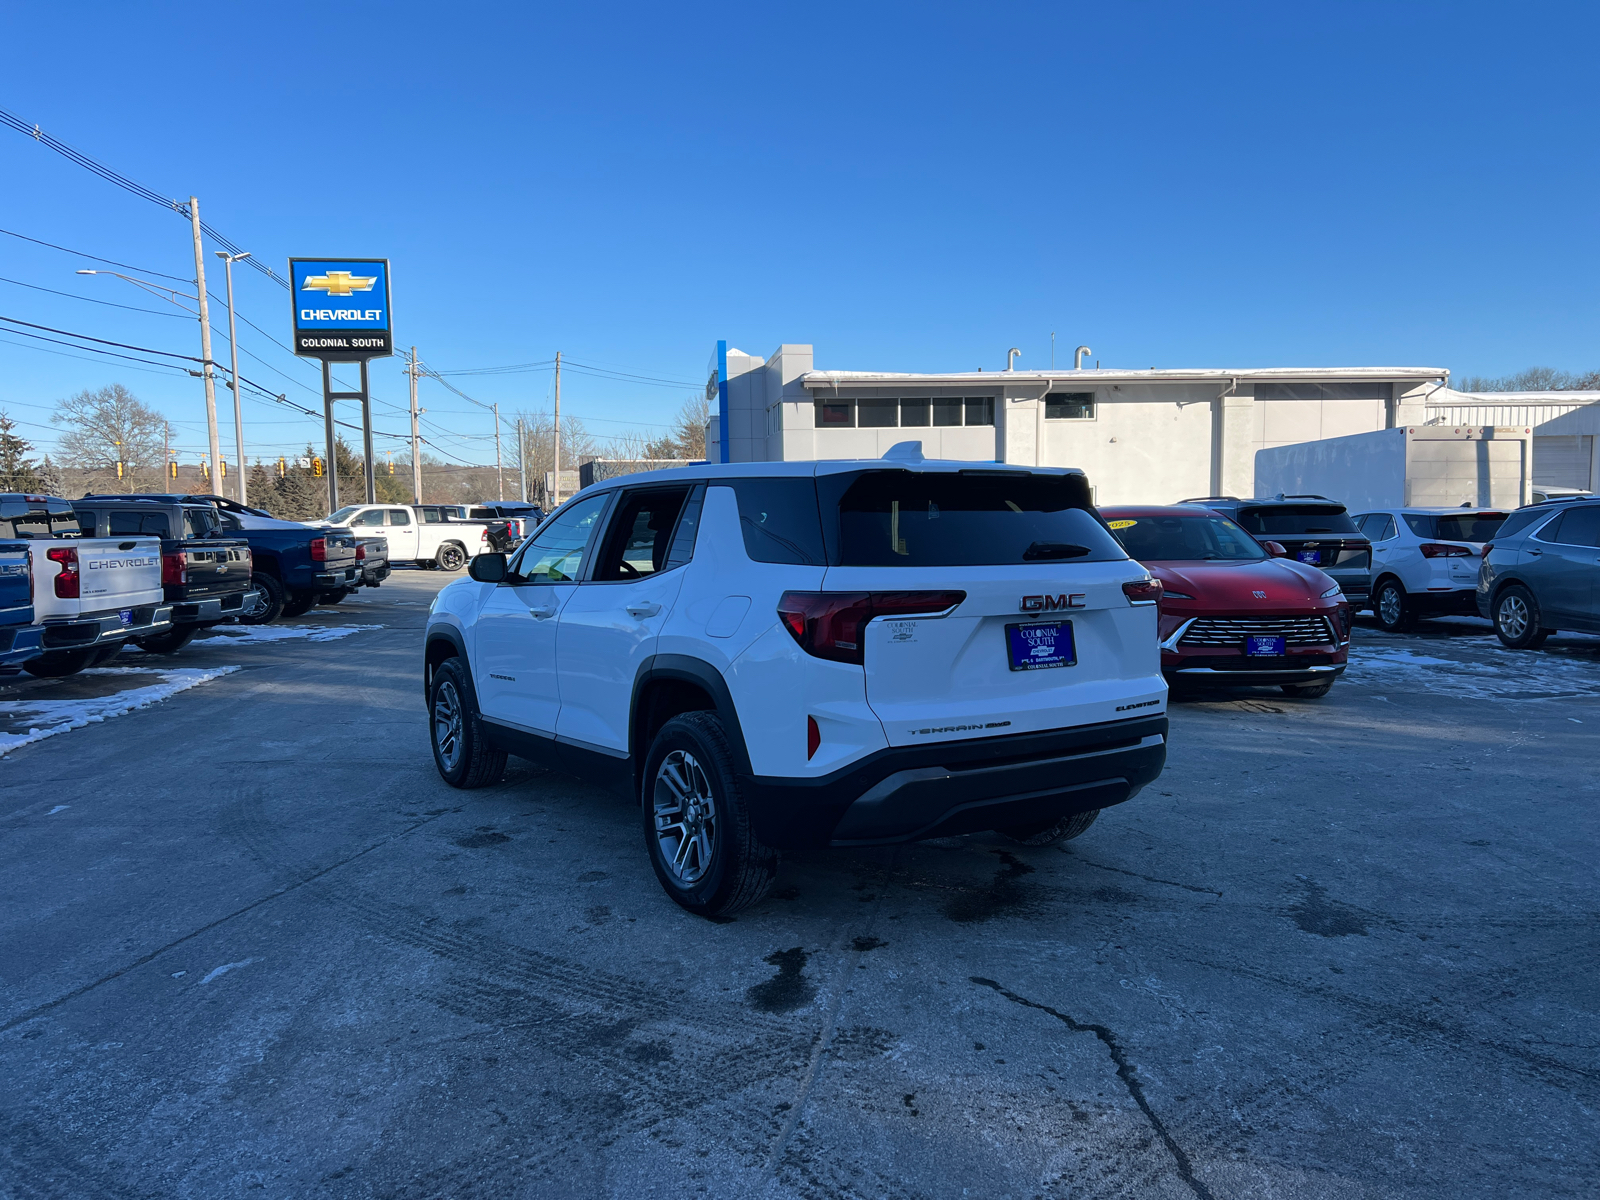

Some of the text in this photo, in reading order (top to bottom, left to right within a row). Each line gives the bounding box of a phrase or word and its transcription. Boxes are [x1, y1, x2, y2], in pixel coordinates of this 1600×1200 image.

[301, 309, 382, 320] CHEVROLET
[301, 338, 384, 347] COLONIAL SOUTH
[89, 557, 160, 570] CHEVROLET
[1019, 593, 1086, 612] GMC
[1021, 628, 1059, 639] COLONIAL
[1027, 636, 1055, 647] SOUTH
[1115, 699, 1160, 711] ELEVATION
[907, 723, 984, 735] TERRAIN
